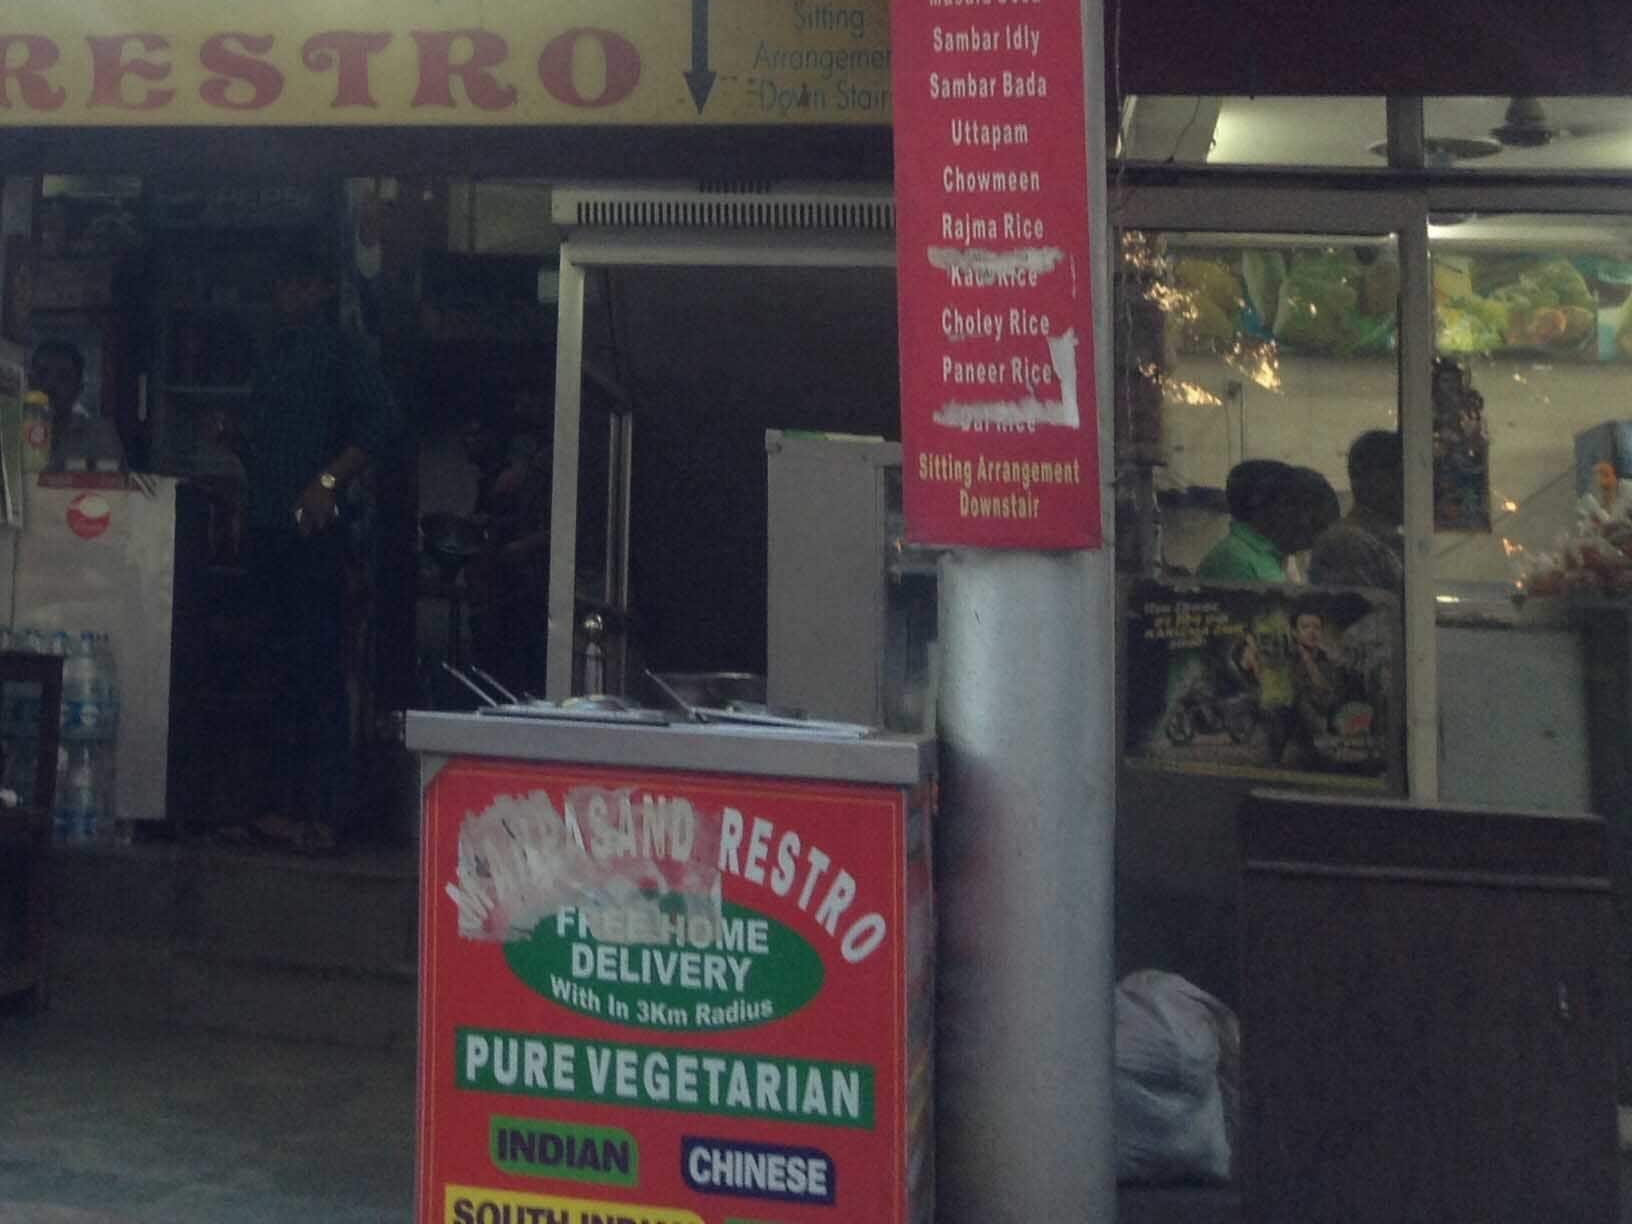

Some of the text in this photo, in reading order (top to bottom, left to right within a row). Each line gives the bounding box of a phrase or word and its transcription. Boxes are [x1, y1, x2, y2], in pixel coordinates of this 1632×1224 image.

[933, 24, 1040, 55] Sambar Idly
[930, 71, 1047, 100] Sambar Bada
[952, 120, 1028, 151] Uttapam
[943, 167, 1040, 193] Chowmeen
[942, 213, 1044, 245] Rajma Rice
[942, 308, 1050, 342] Choley Rice
[942, 357, 1053, 384] Paneer Rice
[919, 452, 1080, 490] Sitting Arrangement
[959, 488, 1040, 520] Downstair
[720, 807, 887, 963] RESTRO
[571, 942, 752, 993] DELIVERY
[551, 975, 774, 1027] With In 3Km Radius
[465, 1034, 862, 1119] PURE VEGETARIAN
[496, 1128, 630, 1175] INDIAN
[689, 1146, 829, 1196] CHINESE
